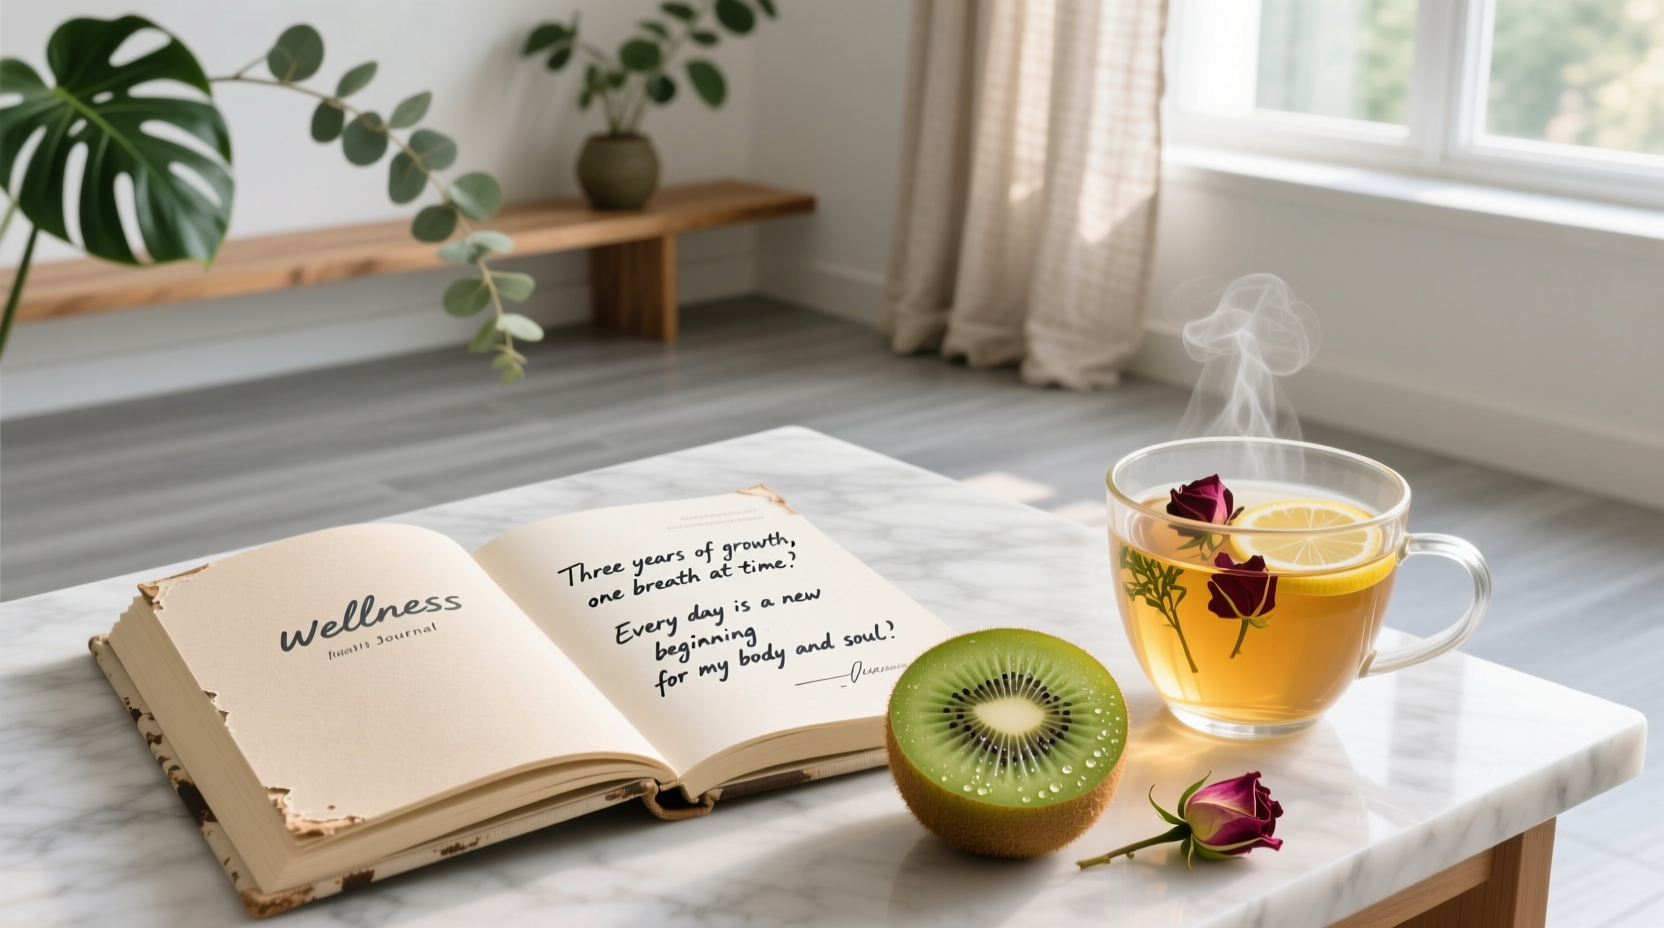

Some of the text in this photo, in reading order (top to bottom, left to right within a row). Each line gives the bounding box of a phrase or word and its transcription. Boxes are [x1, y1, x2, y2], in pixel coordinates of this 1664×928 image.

[556, 530, 796, 587] Three years of growth,
[587, 550, 797, 609] one breath at time?
[376, 621, 438, 646] Journal
[614, 588, 821, 646] Every day is a new
[655, 626, 758, 664] beginning
[654, 619, 896, 698] for my body and soul?
